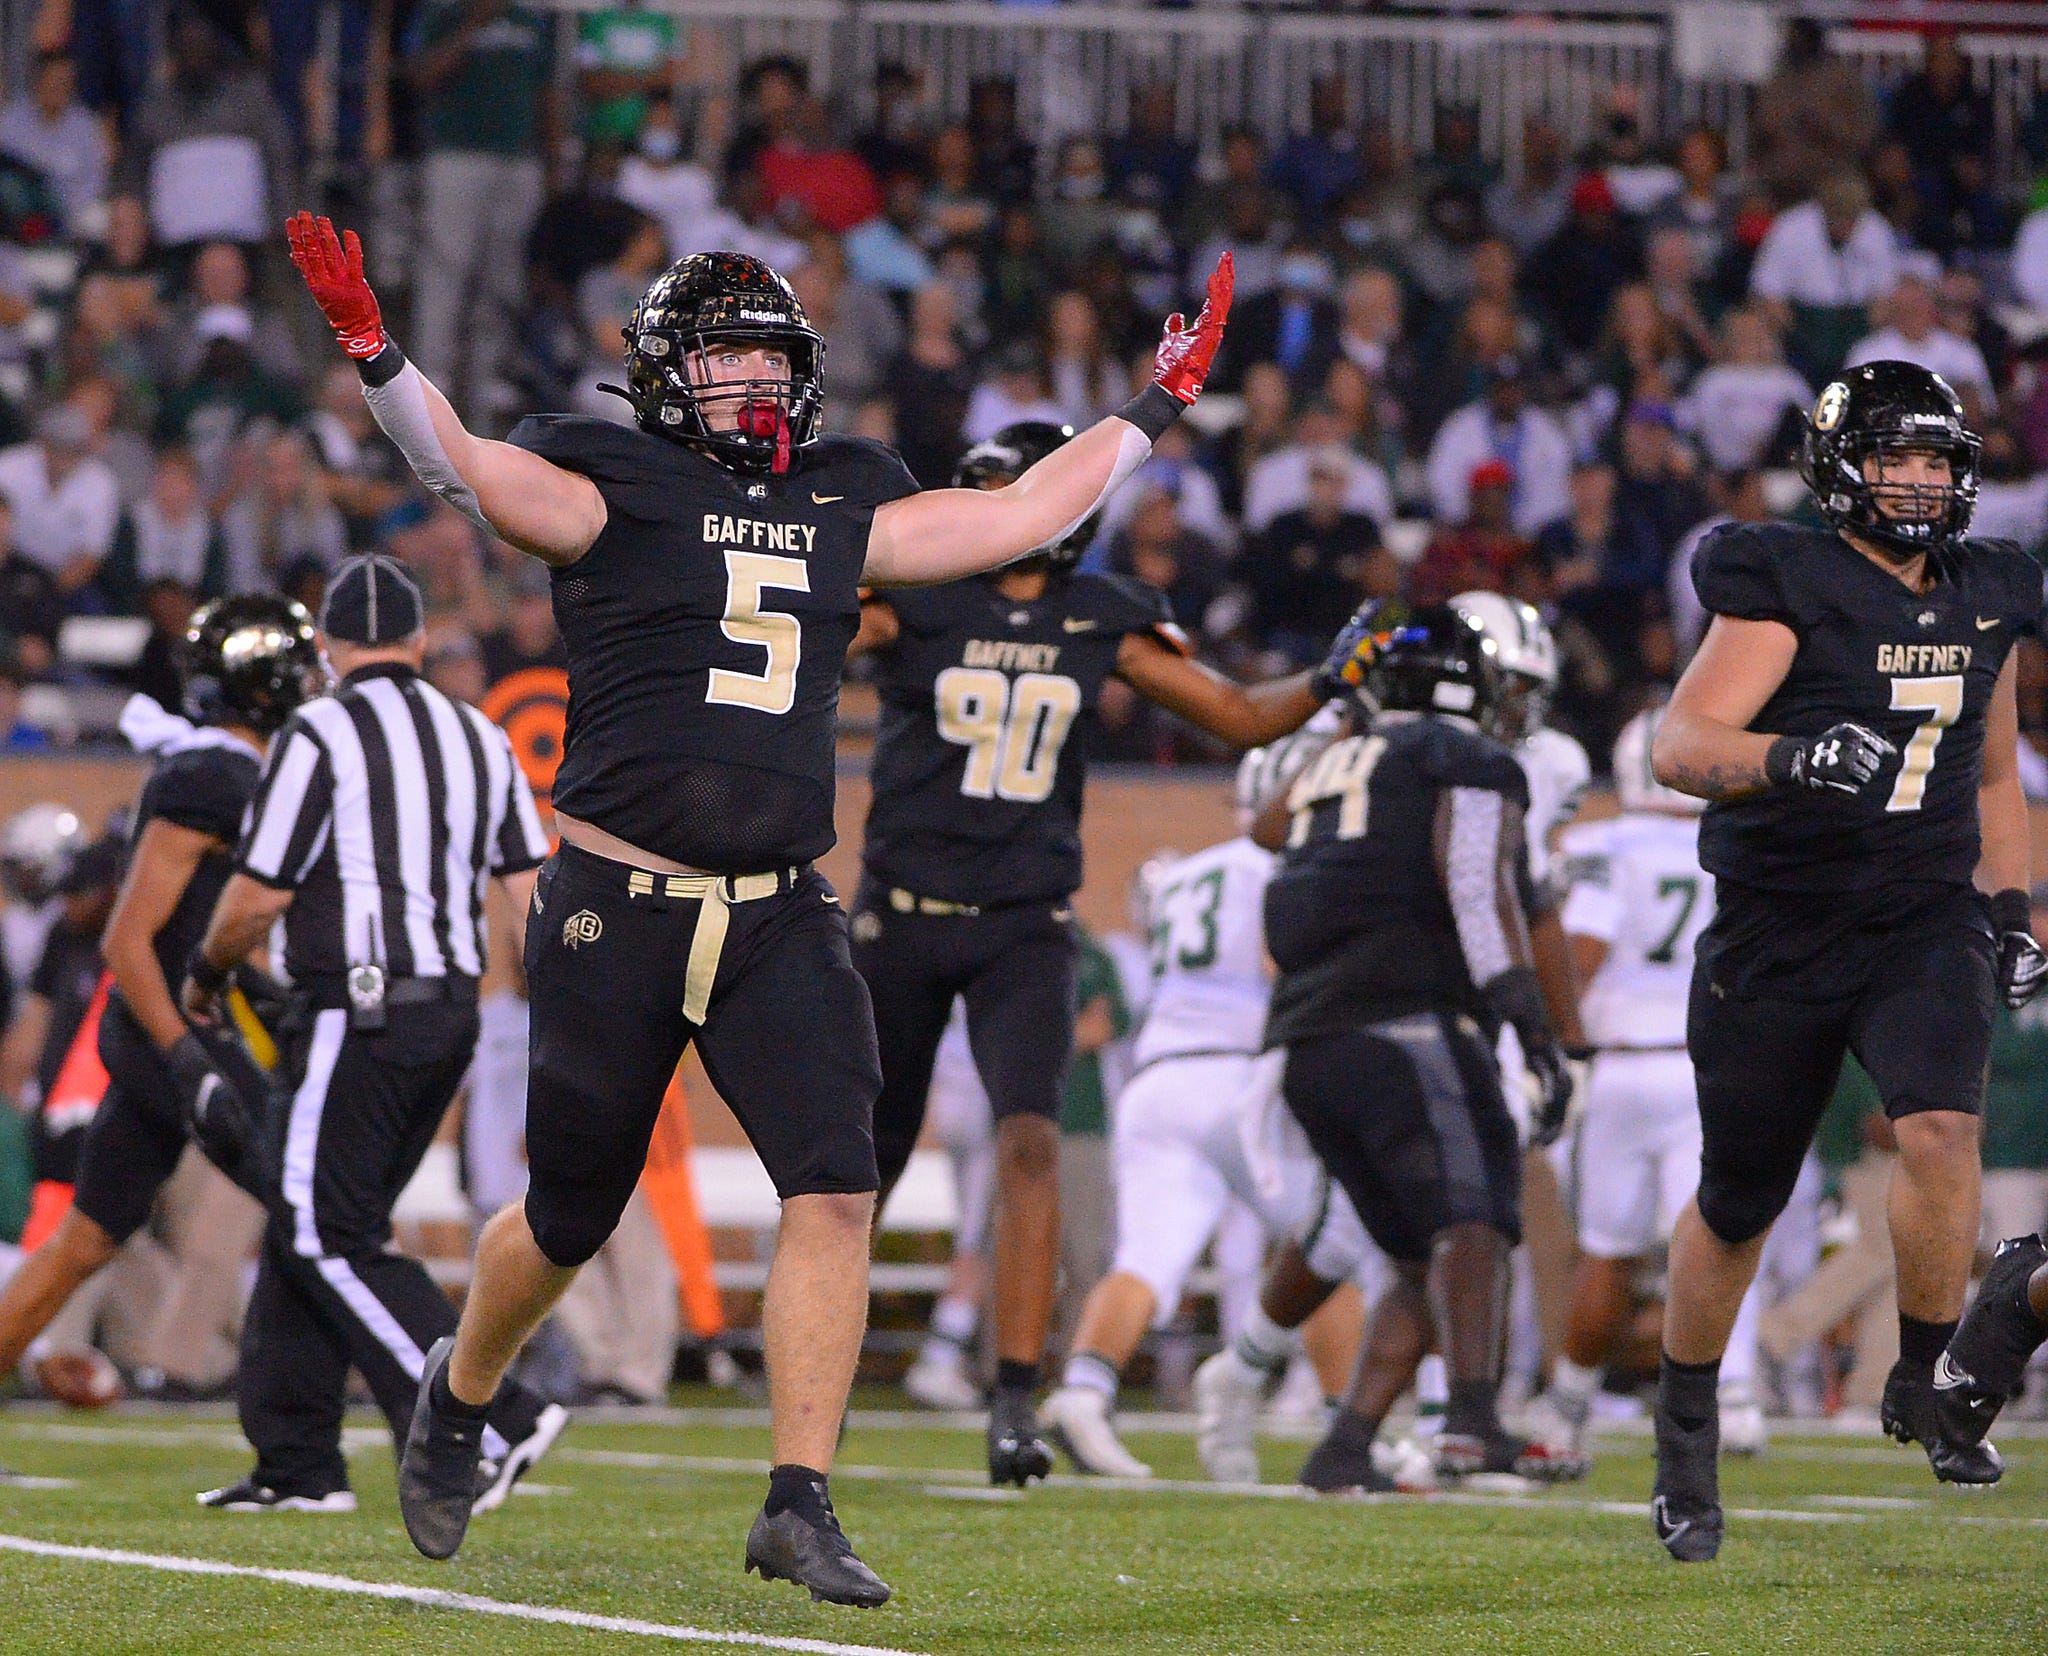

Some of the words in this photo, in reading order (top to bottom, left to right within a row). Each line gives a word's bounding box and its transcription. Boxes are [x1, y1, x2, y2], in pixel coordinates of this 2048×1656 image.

[740, 309, 787, 323] Riddell
[703, 514, 817, 552] GAFFNEY
[705, 550, 811, 715] 5
[962, 639, 1061, 672] GAFFNEY
[1876, 643, 1973, 674] GAFFNEY
[934, 666, 1082, 803] 90
[1885, 674, 1964, 812] 7
[1645, 873, 1699, 963] 7
